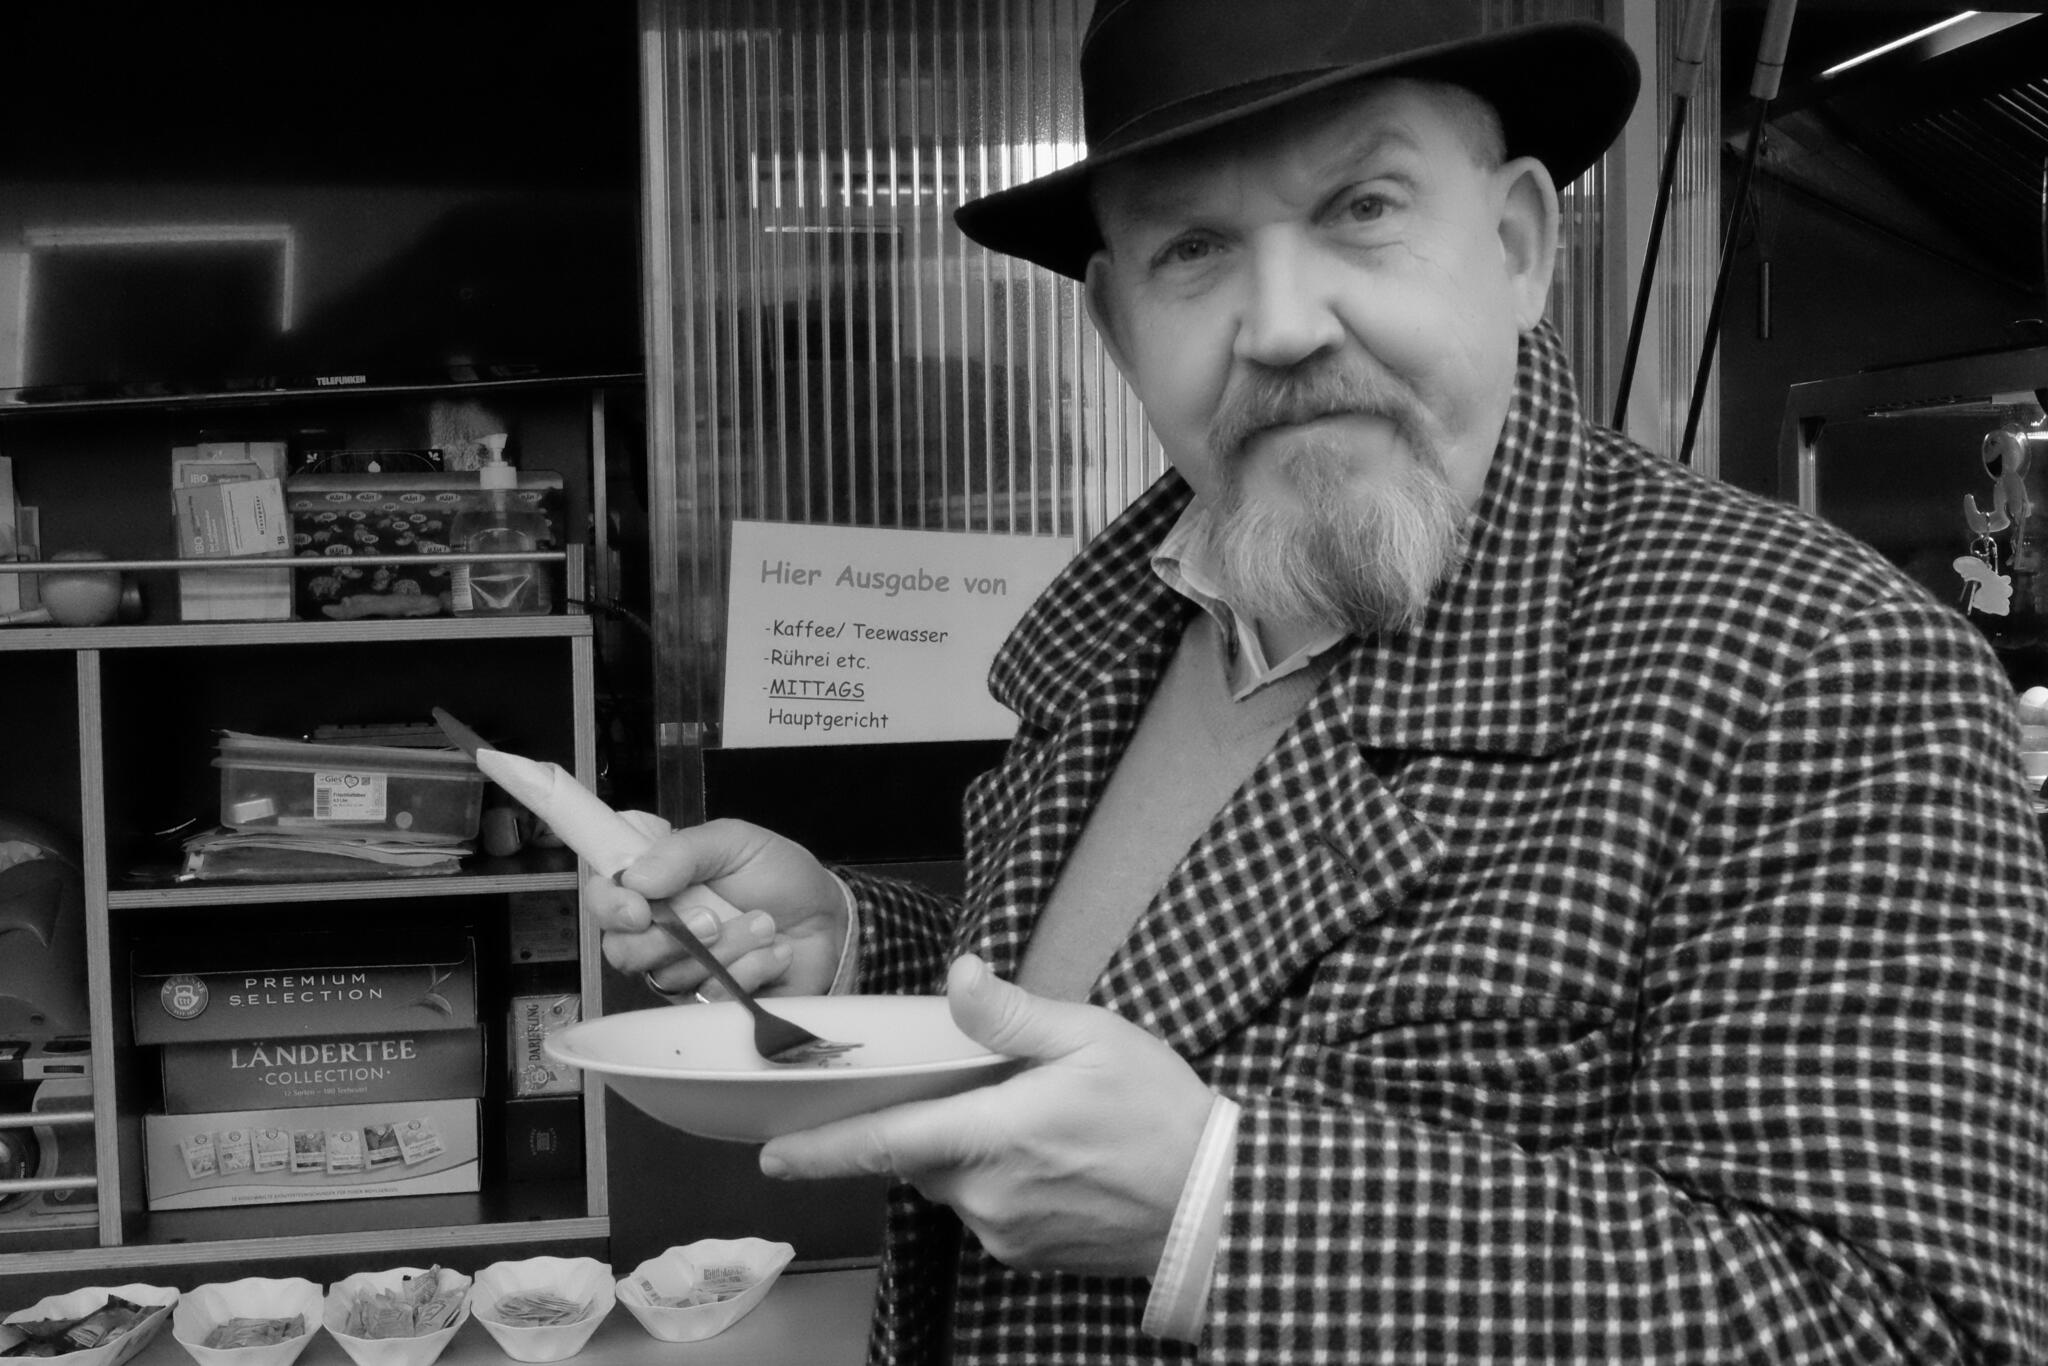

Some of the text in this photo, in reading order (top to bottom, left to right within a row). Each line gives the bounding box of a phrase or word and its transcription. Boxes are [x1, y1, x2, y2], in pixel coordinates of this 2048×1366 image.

[316, 375, 366, 386] TELEFUNKEN
[760, 559, 1007, 597] Hier Ausgabe von
[853, 622, 949, 644] Teewasser
[763, 649, 871, 670] -Rührei etc.
[762, 679, 865, 699] -MITTAGS
[768, 708, 889, 731] Hauptgericht
[245, 973, 366, 989] PREMIUM
[229, 988, 382, 1006] SELECTION
[231, 1039, 417, 1069] LÄNDERTEE
